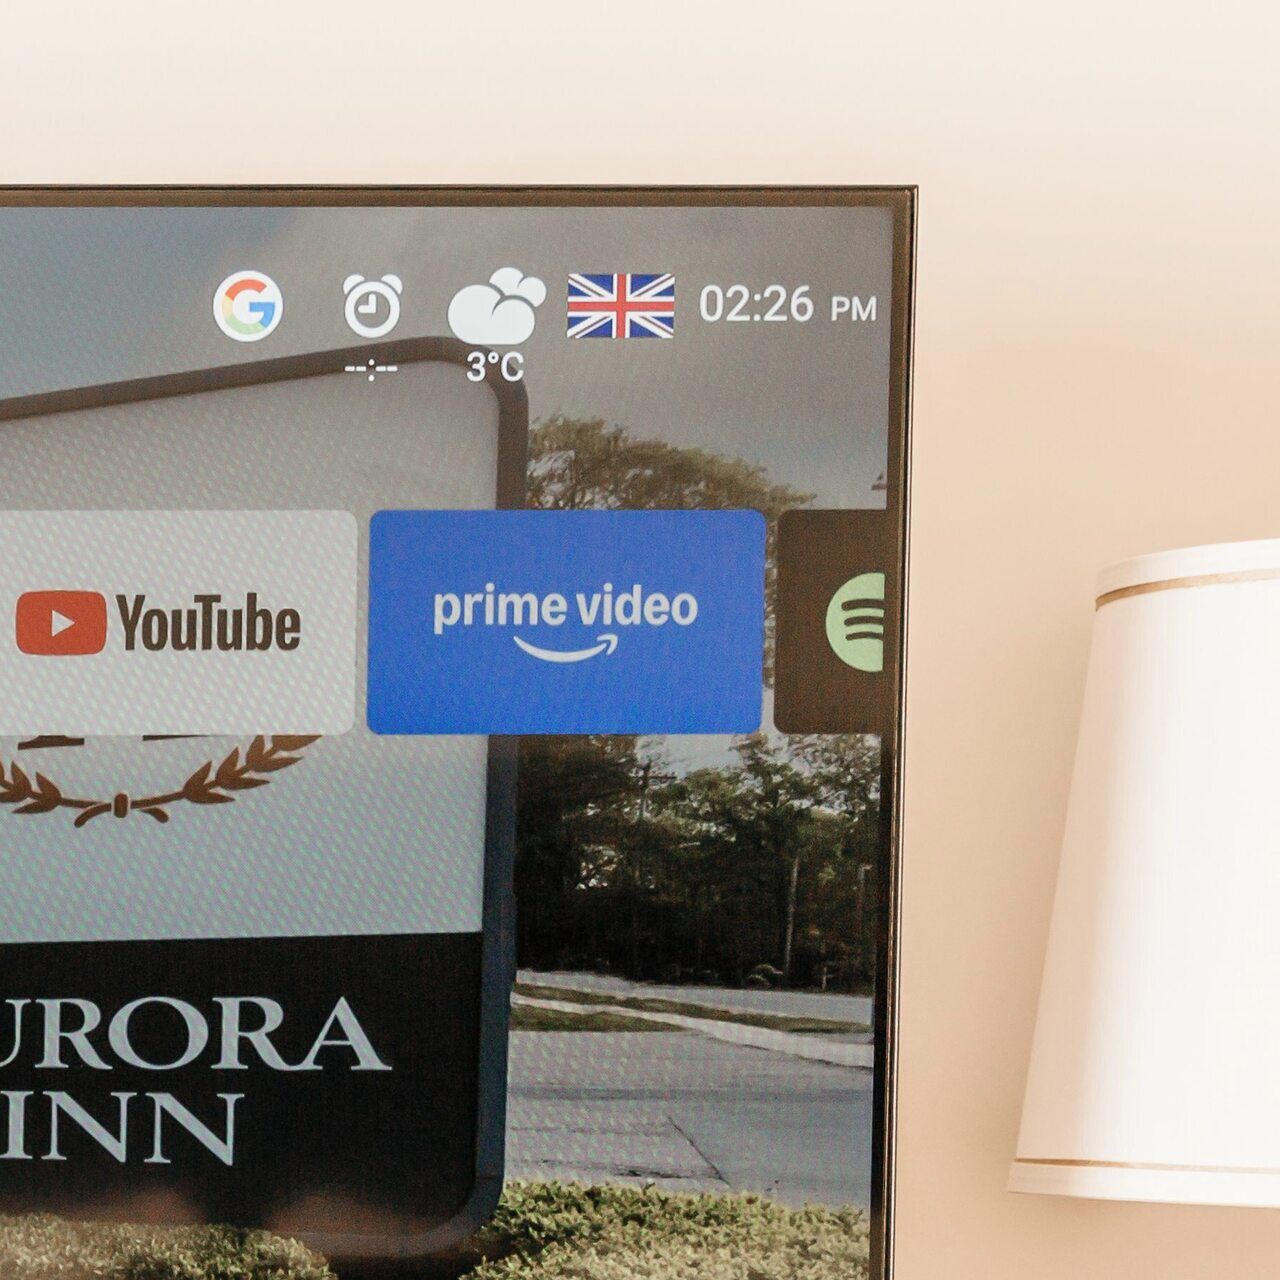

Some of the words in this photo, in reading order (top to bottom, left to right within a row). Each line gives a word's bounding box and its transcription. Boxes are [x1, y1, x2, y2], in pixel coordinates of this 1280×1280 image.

[698, 284, 814, 323] 02:26
[830, 296, 878, 322] PM
[466, 351, 525, 383] 3°C
[115, 592, 302, 652] YouTube
[433, 582, 568, 635] prime
[576, 582, 699, 627] video
